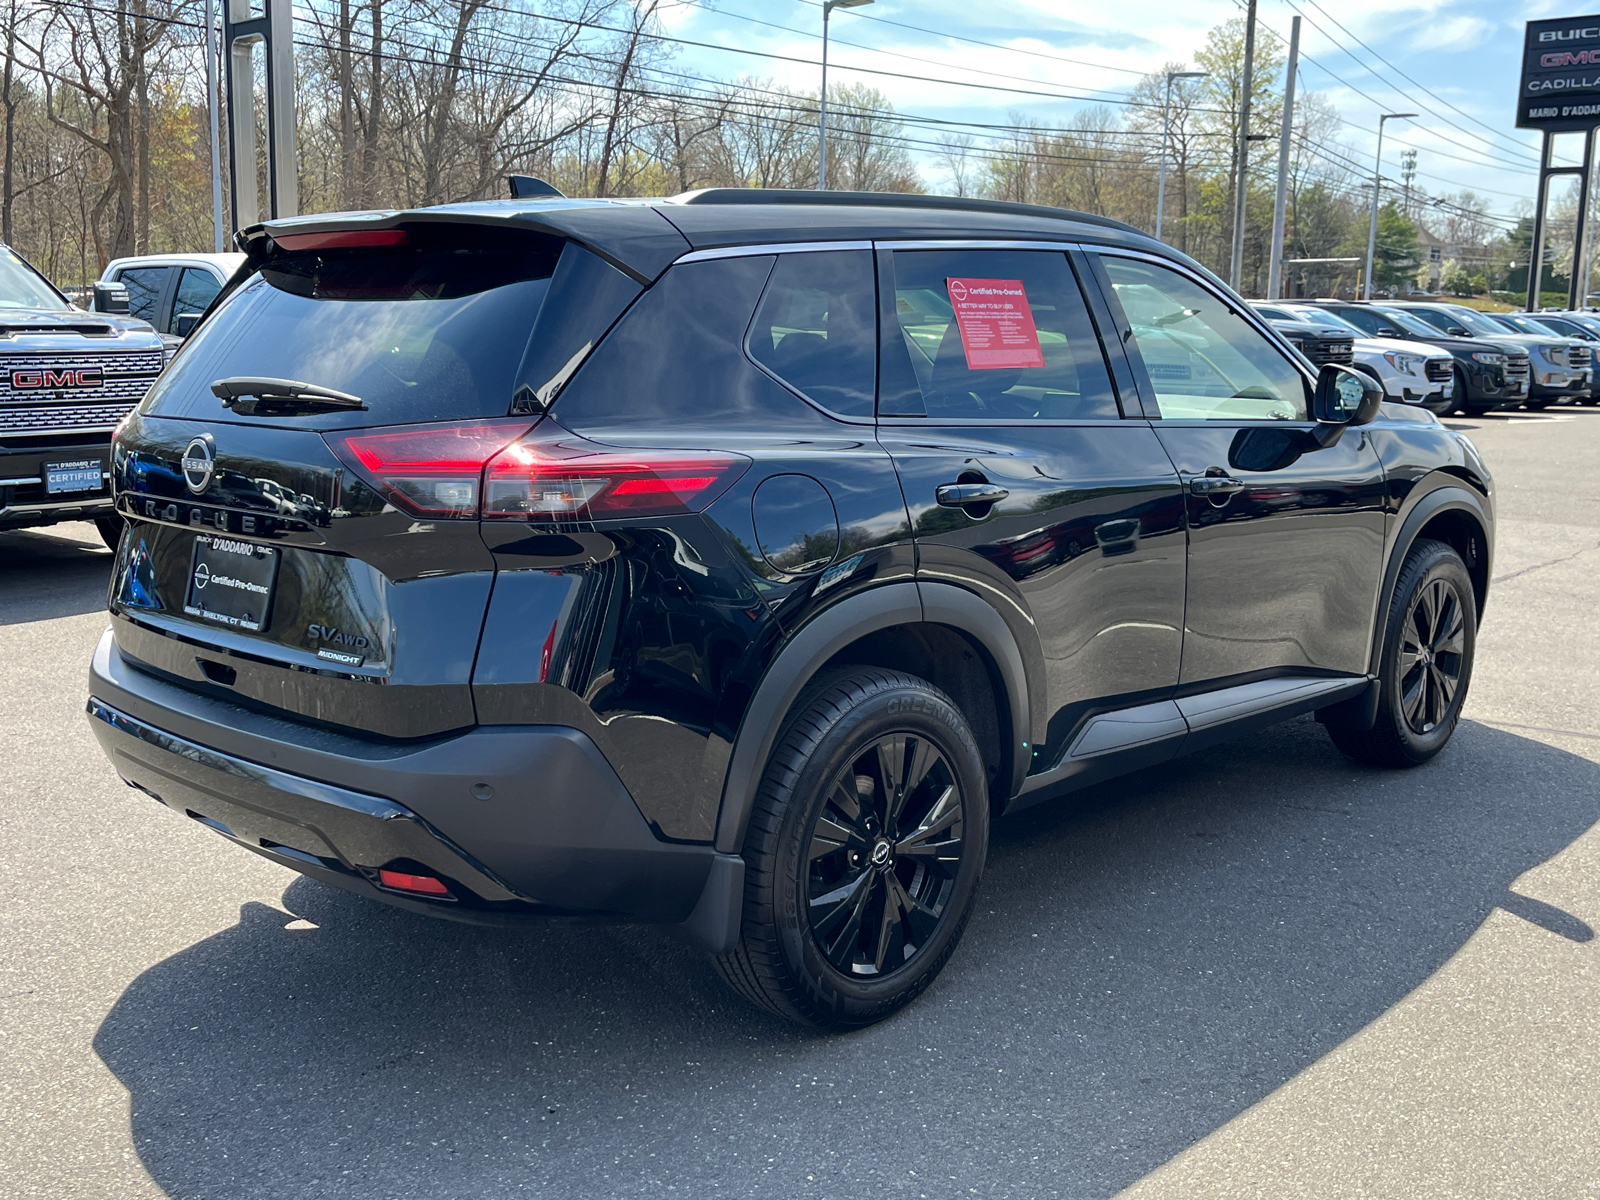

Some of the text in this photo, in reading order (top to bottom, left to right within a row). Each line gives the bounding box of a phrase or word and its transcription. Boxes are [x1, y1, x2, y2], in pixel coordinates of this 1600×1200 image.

[1539, 27, 1600, 42] BUIC
[1528, 106, 1558, 118] MARIO
[969, 287, 1023, 296] Certified Pre-Owned
[12, 369, 102, 388] GMC
[183, 459, 213, 472] SSAN
[48, 471, 100, 483] CERTIFIED
[145, 500, 257, 533] ROGUE
[212, 538, 253, 556] D'ADDARIO
[256, 546, 273, 555] GMC
[211, 574, 235, 588] Certified
[230, 617, 238, 625] CT
[307, 624, 369, 648] SV AWD
[318, 650, 360, 664] MIDNIGHT
